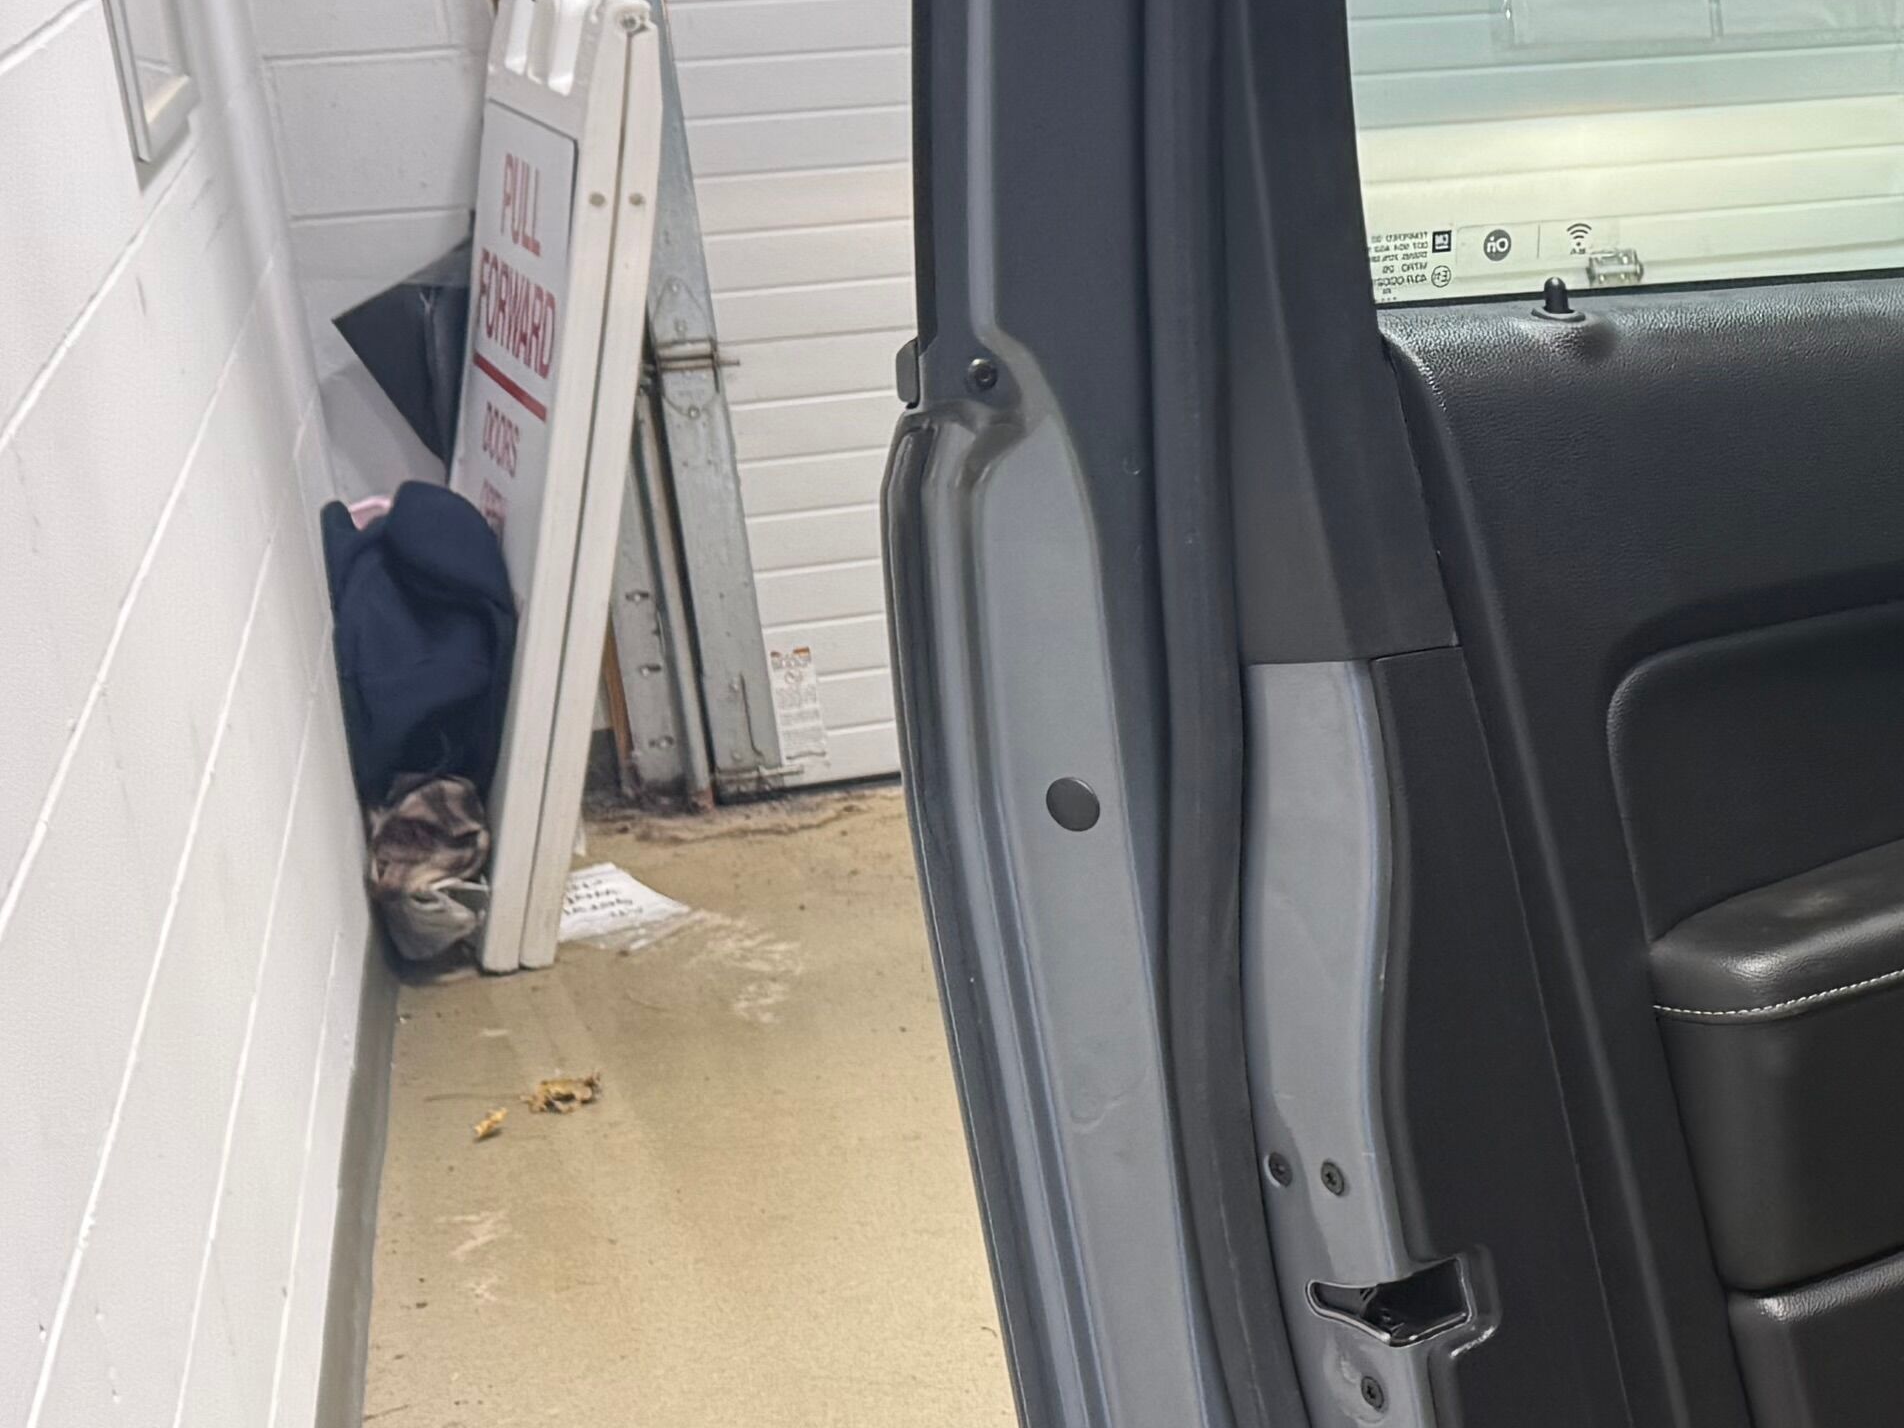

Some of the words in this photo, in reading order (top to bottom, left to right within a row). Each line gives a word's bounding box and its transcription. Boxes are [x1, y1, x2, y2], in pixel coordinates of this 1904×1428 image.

[499, 150, 543, 258] PULL
[477, 247, 557, 380] FORWARD
[482, 399, 521, 479] DOORS
